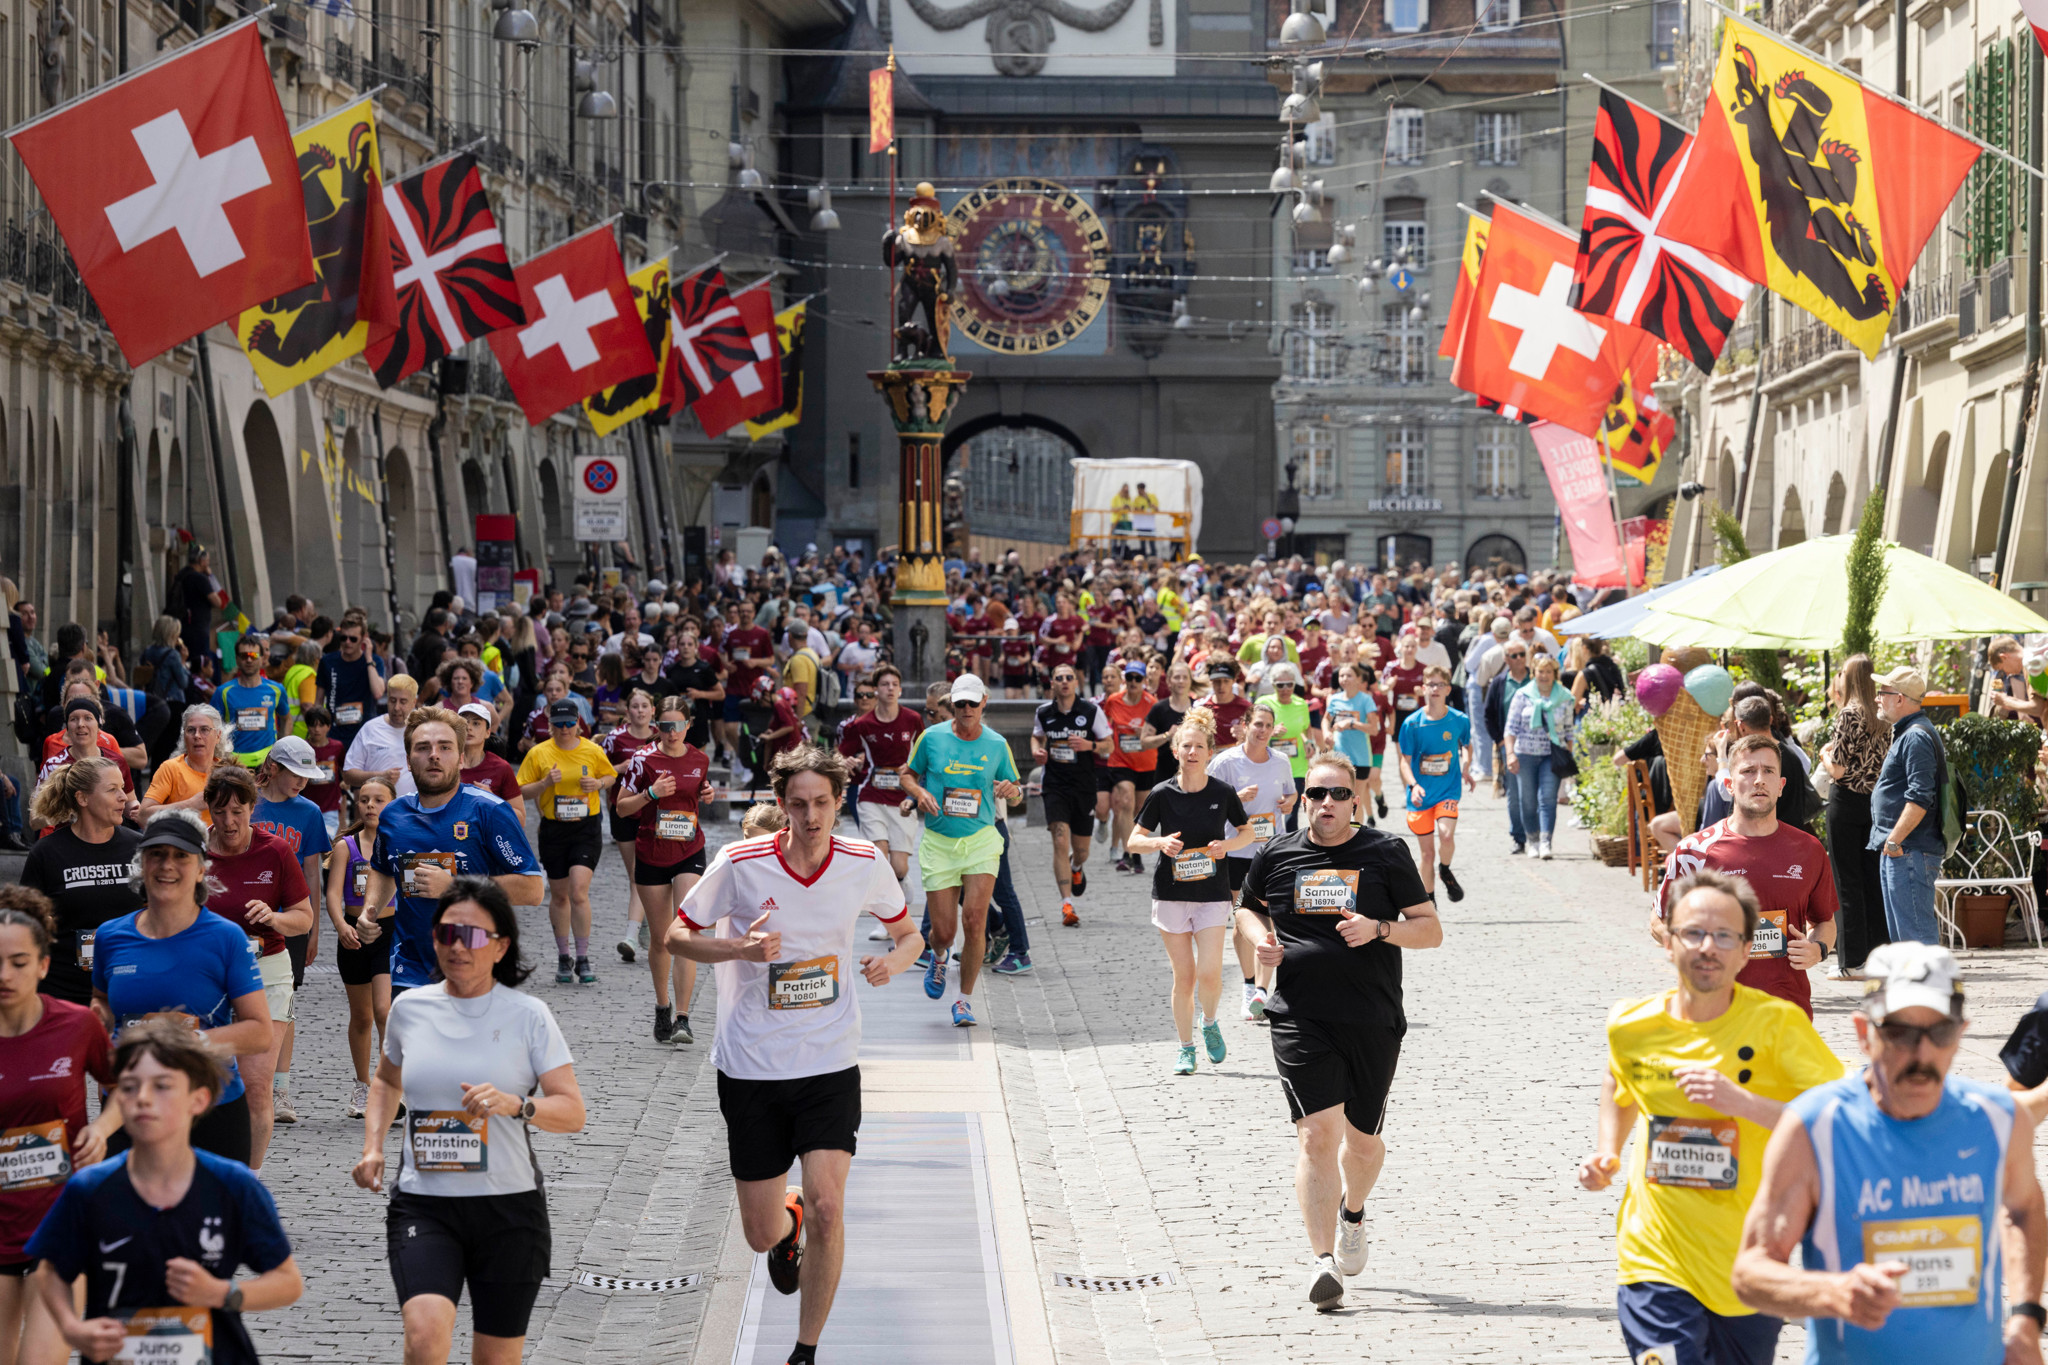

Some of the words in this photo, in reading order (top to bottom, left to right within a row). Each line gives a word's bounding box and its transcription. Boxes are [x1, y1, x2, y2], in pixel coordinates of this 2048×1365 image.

[1368, 499, 1442, 512] BUCHERER
[1443, 801, 1457, 813] 46
[665, 822, 688, 830] Lirona
[1254, 825, 1268, 833] aby
[503, 840, 515, 857] Islas
[1178, 859, 1211, 870] Natanja
[63, 864, 123, 882] CROSSFIT
[1301, 874, 1328, 882] CRAFT
[1305, 887, 1347, 897] Samuel
[1315, 898, 1336, 906] 16976
[1752, 943, 1768, 951] 296
[776, 965, 821, 976] groupemutuel
[783, 978, 827, 992] Patrick
[794, 992, 817, 1001] 10801
[414, 1117, 449, 1127] CRAFT
[414, 1136, 479, 1148] Christine
[431, 1151, 458, 1160] 18919
[1657, 1145, 1726, 1163] Mathias
[1857, 1178, 1893, 1216] AC
[1901, 1172, 1985, 1209] Murten
[1872, 1228, 1928, 1246] CRAFT
[102, 1261, 128, 1309] 7
[135, 1341, 182, 1355] Juno
